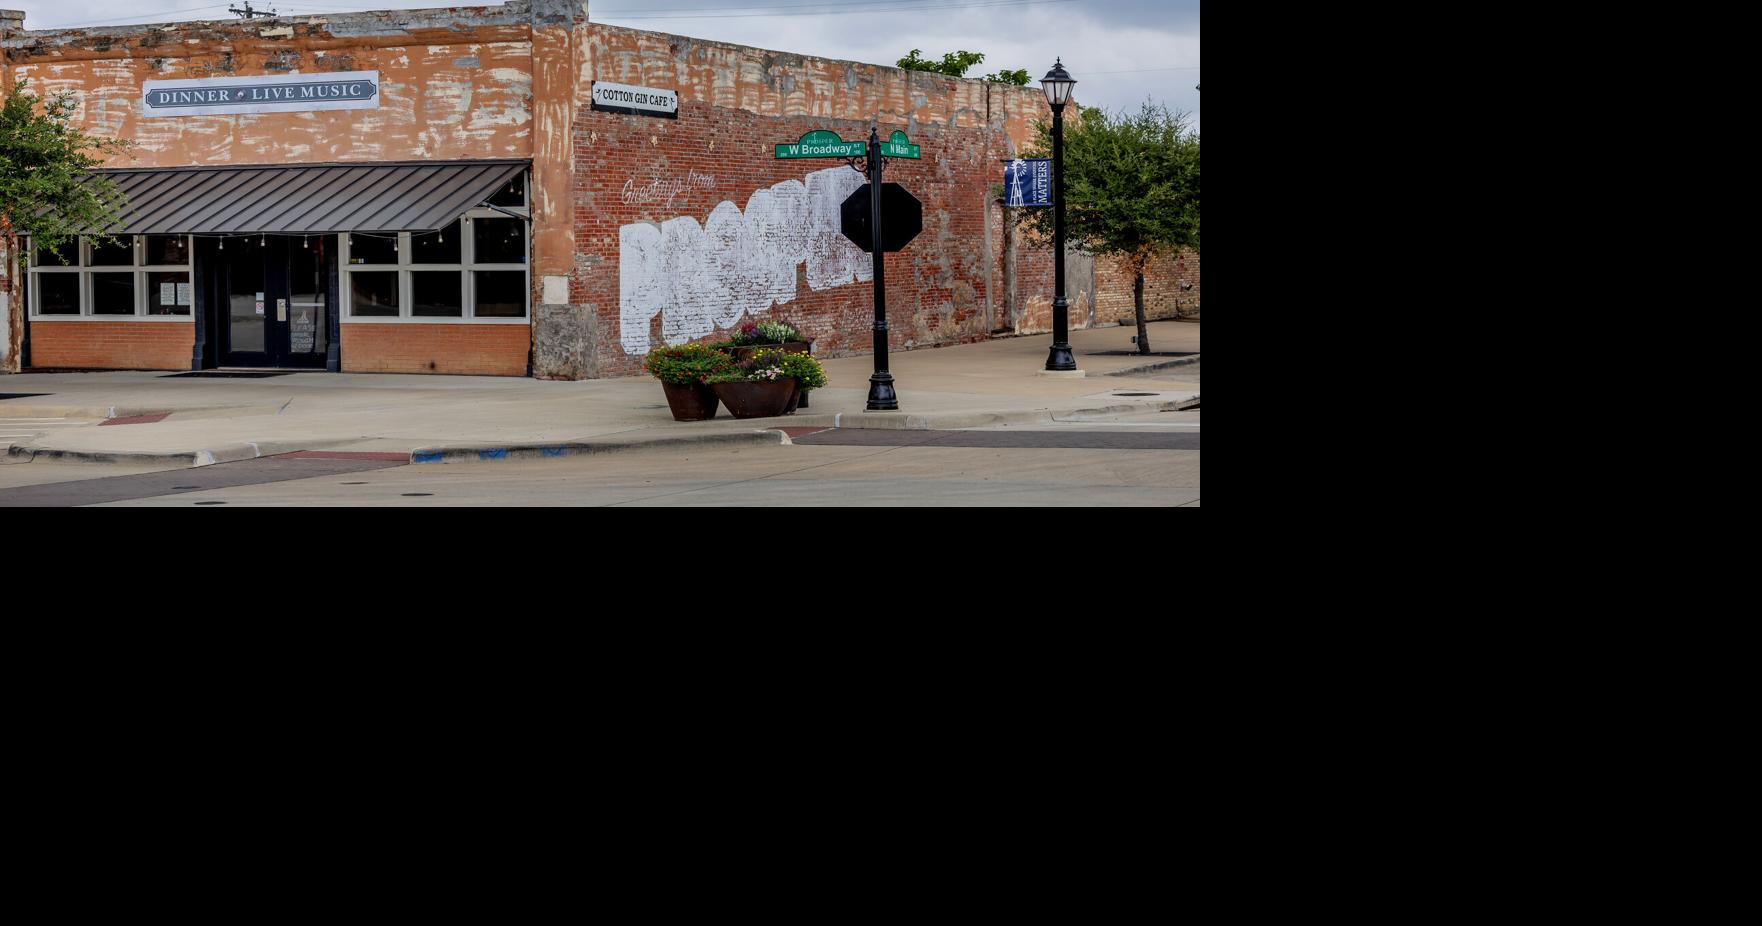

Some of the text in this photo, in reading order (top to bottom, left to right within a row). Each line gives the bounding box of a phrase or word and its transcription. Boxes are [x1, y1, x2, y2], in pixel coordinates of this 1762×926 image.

[159, 84, 362, 104] DINNER LIVE MUSIC
[603, 89, 668, 106] COTTON GIN CAFE
[789, 144, 799, 155] W
[801, 144, 852, 156] Broadway
[890, 143, 895, 154] N
[895, 144, 909, 155] Main
[1037, 161, 1047, 203] MATTERS
